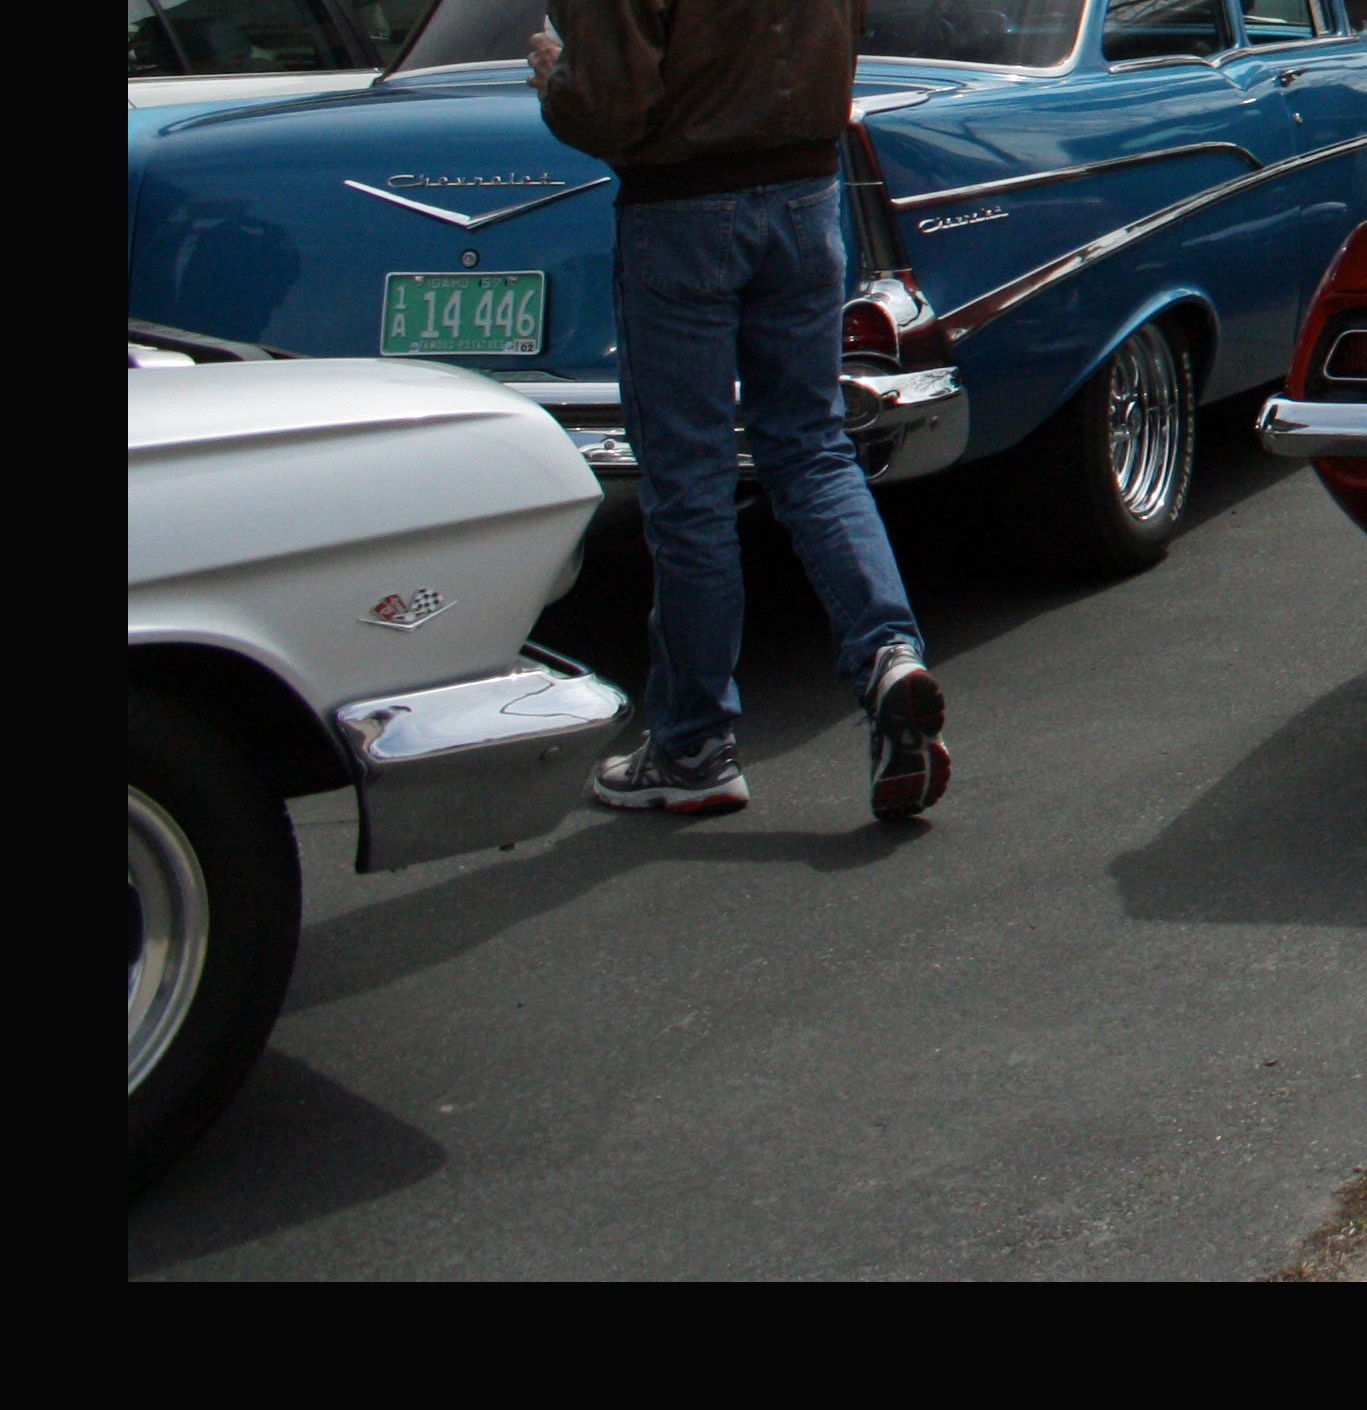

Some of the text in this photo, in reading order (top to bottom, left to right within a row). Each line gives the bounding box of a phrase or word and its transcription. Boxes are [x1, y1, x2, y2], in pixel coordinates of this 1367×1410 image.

[428, 277, 470, 289] IDAHO
[420, 290, 536, 339] 14 446
[391, 312, 407, 338] A
[520, 344, 534, 353] 02
